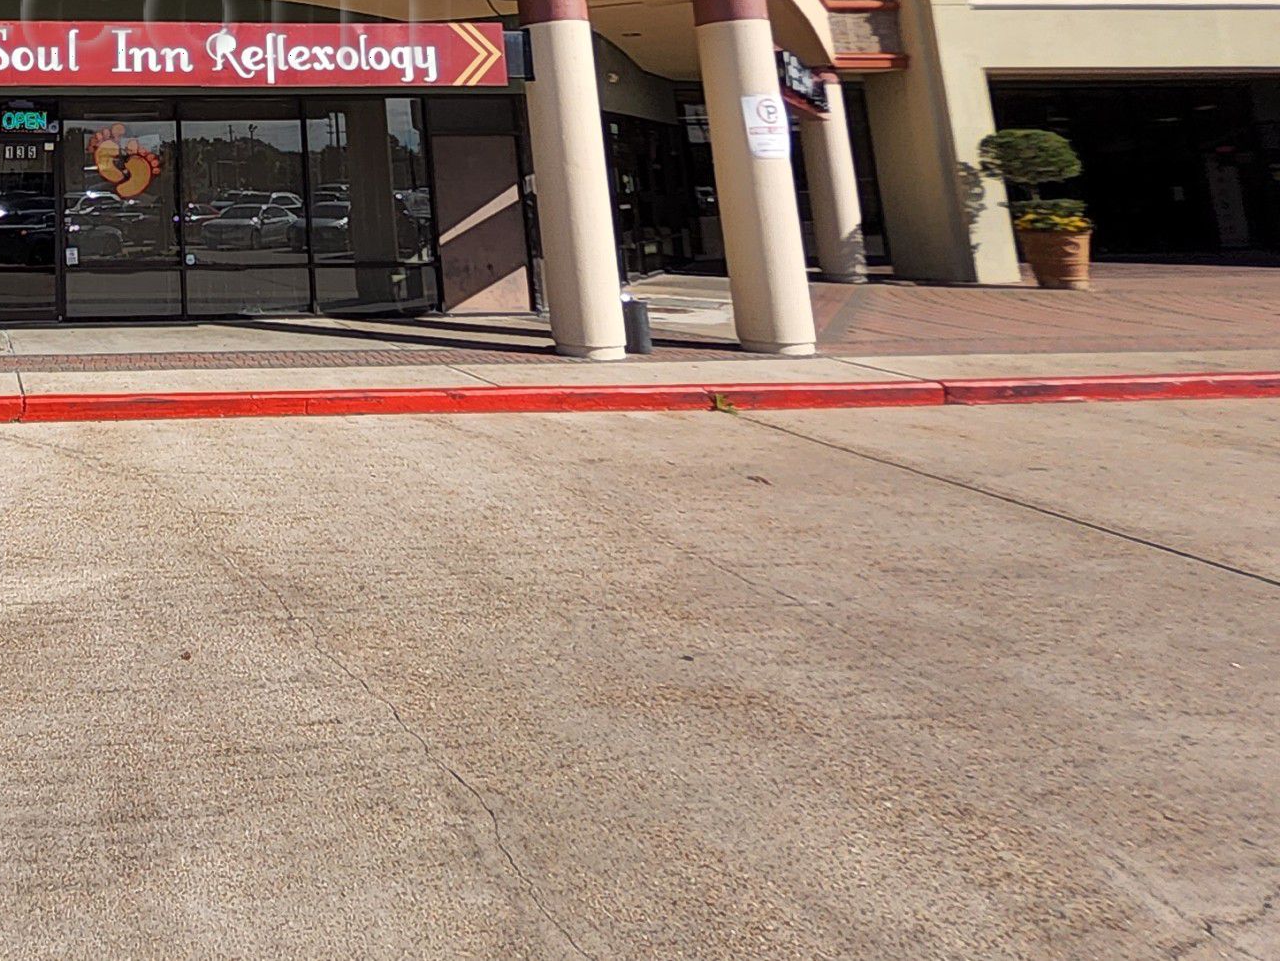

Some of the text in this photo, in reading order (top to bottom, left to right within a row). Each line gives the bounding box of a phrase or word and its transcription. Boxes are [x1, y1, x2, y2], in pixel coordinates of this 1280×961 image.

[111, 29, 193, 73] Inn
[206, 30, 437, 84] Reflexology
[2, 112, 47, 129] OPEN
[5, 146, 36, 158] 135
